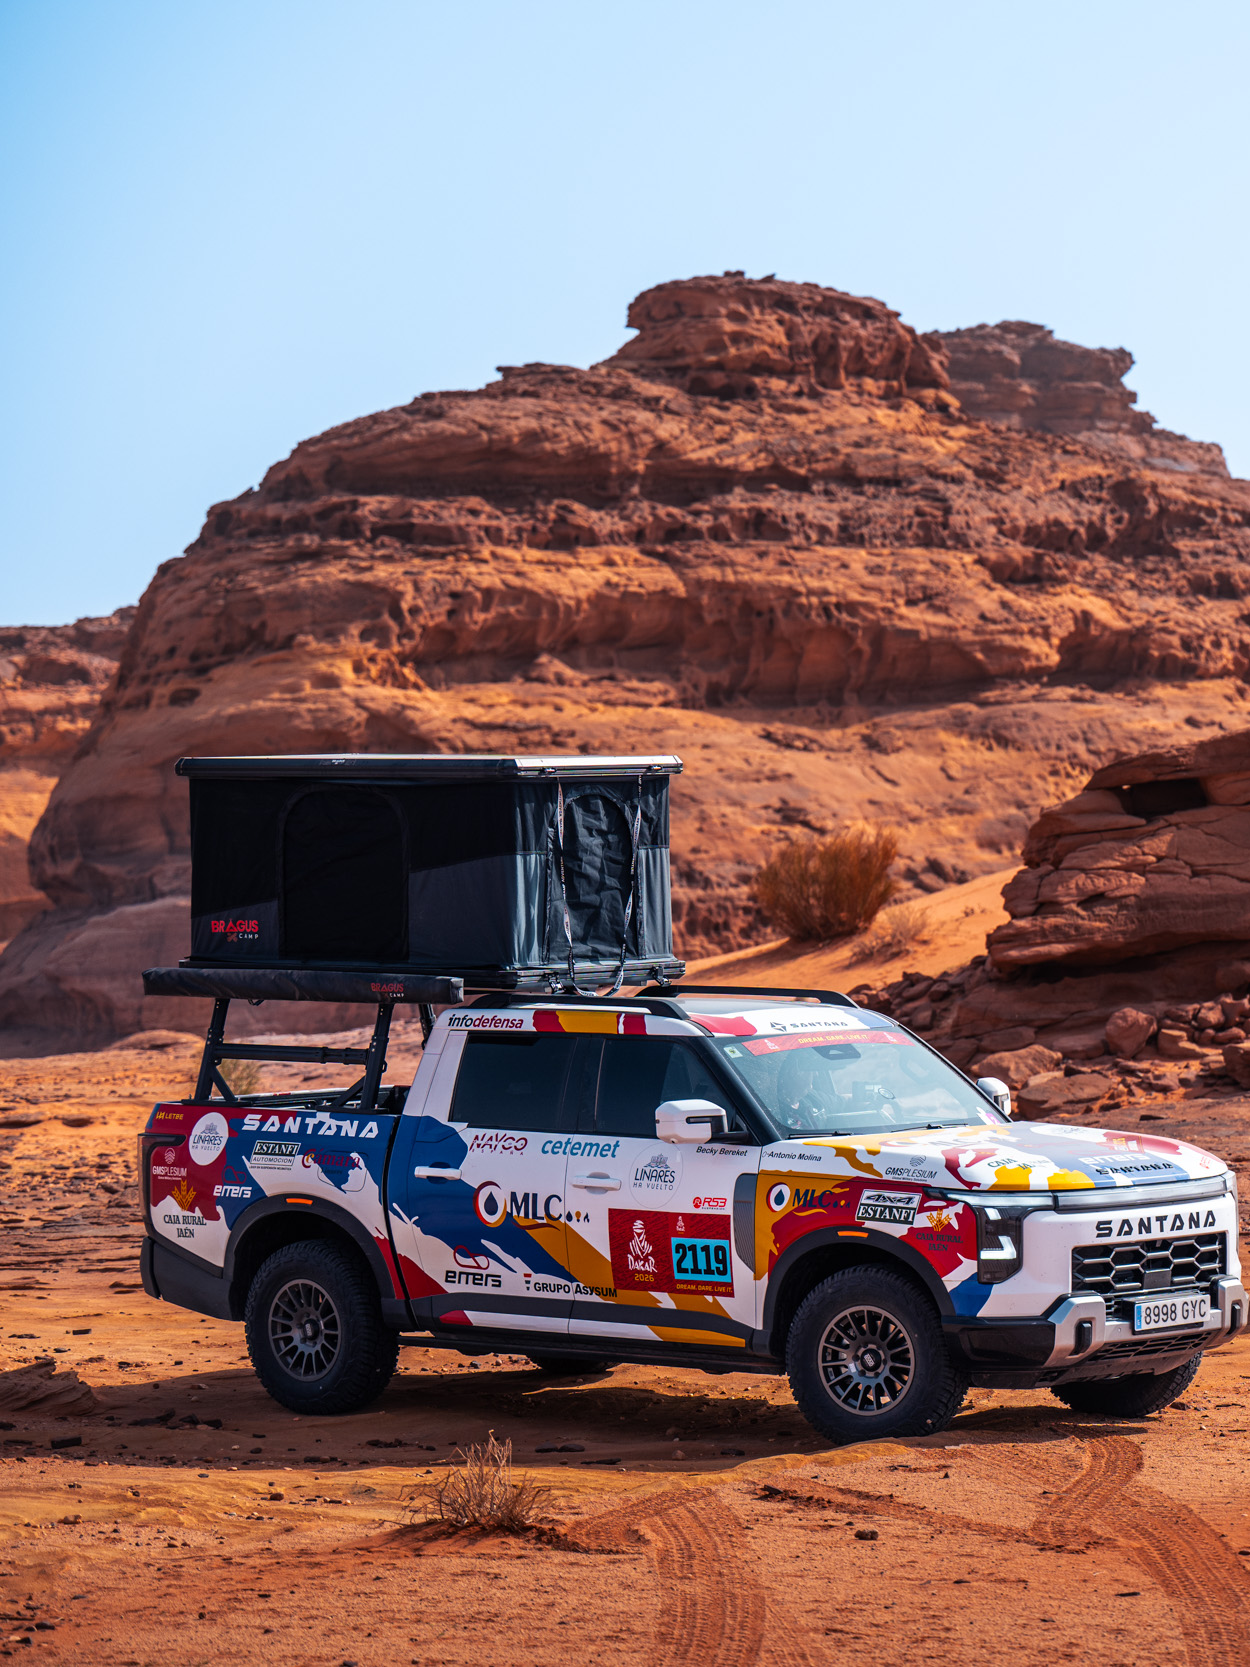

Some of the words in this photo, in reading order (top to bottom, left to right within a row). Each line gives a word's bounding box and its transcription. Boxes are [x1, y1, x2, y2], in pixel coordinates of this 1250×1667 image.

[211, 919, 259, 933] BRAGUS
[370, 982, 404, 993] BRAGUS
[448, 1013, 524, 1029] infodefensa
[790, 1021, 848, 1029] SANTANA
[798, 1035, 826, 1045] DREAM.
[242, 1113, 379, 1139] SANTANA
[193, 1134, 223, 1146] LINARES
[255, 1142, 298, 1155] ESTANFI
[541, 1137, 620, 1158] cetemet
[696, 1146, 718, 1156] Becky
[719, 1147, 748, 1156] Bereket
[301, 1148, 361, 1169] Cámara
[768, 1151, 797, 1160] Antonio
[798, 1153, 822, 1162] Molina
[153, 1165, 187, 1177] GMSPLESIUM
[634, 1168, 675, 1184] LINARES
[885, 1167, 938, 1179] GMSPLESIUM
[646, 1183, 674, 1191] VUELTO
[703, 1197, 727, 1208] RS3
[792, 1189, 834, 1208] MLC
[509, 1191, 562, 1222] MLC
[858, 1205, 915, 1222] ESTANFI
[163, 1215, 181, 1225] CAJA
[182, 1215, 207, 1226] RURAL
[1095, 1210, 1216, 1238] SANTANA
[176, 1227, 195, 1238] JAÉN
[936, 1234, 964, 1243] RURAL
[627, 1253, 658, 1273] DAKAR
[674, 1243, 728, 1276] 2119
[634, 1273, 655, 1282] 2026
[533, 1282, 571, 1294] GRUPO
[676, 1283, 698, 1291] DREAM.
[1144, 1304, 1177, 1325] 8998
[1181, 1299, 1207, 1320] GYC
